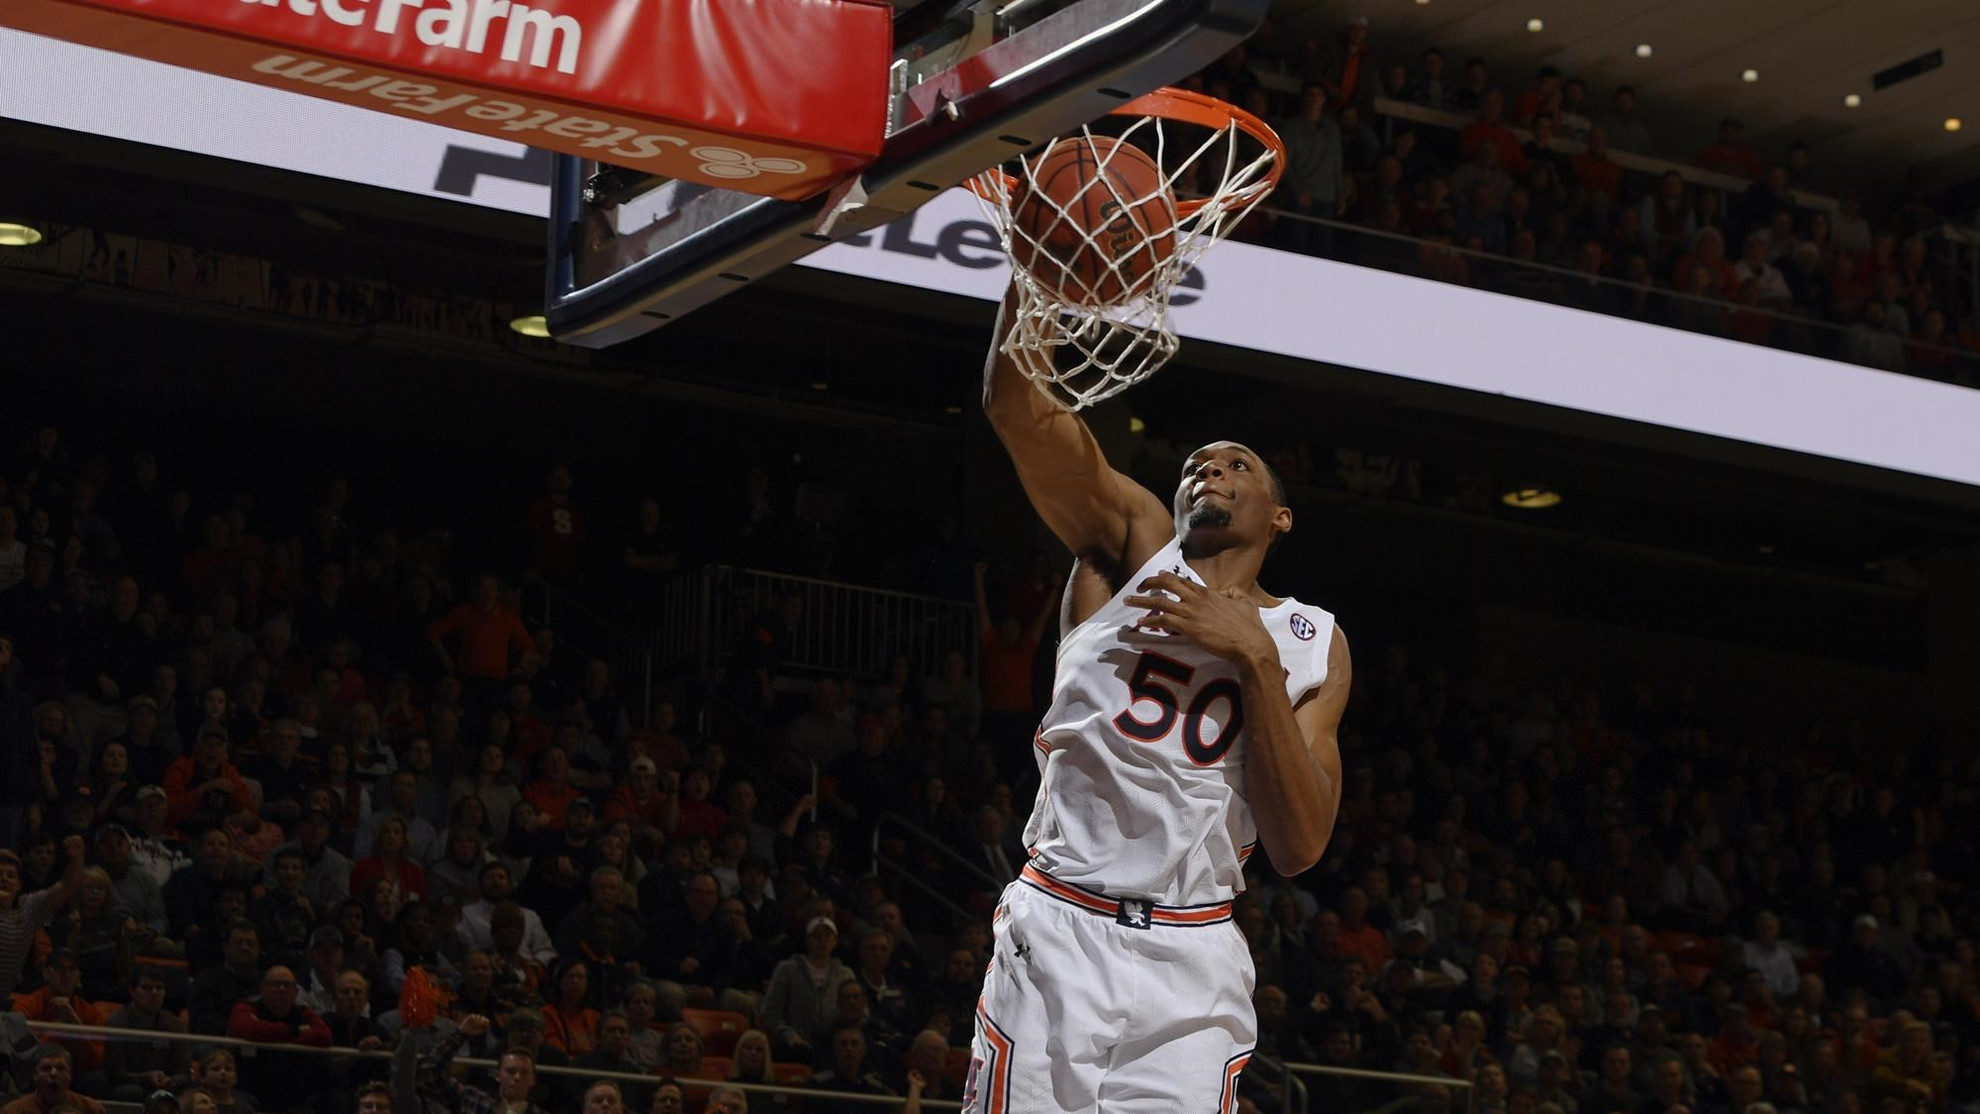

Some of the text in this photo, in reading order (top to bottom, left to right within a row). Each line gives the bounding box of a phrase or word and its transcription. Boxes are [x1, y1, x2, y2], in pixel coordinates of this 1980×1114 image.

[252, 54, 689, 158] StateFarm
[1291, 614, 1314, 639] SEC
[1112, 649, 1244, 767] 50
